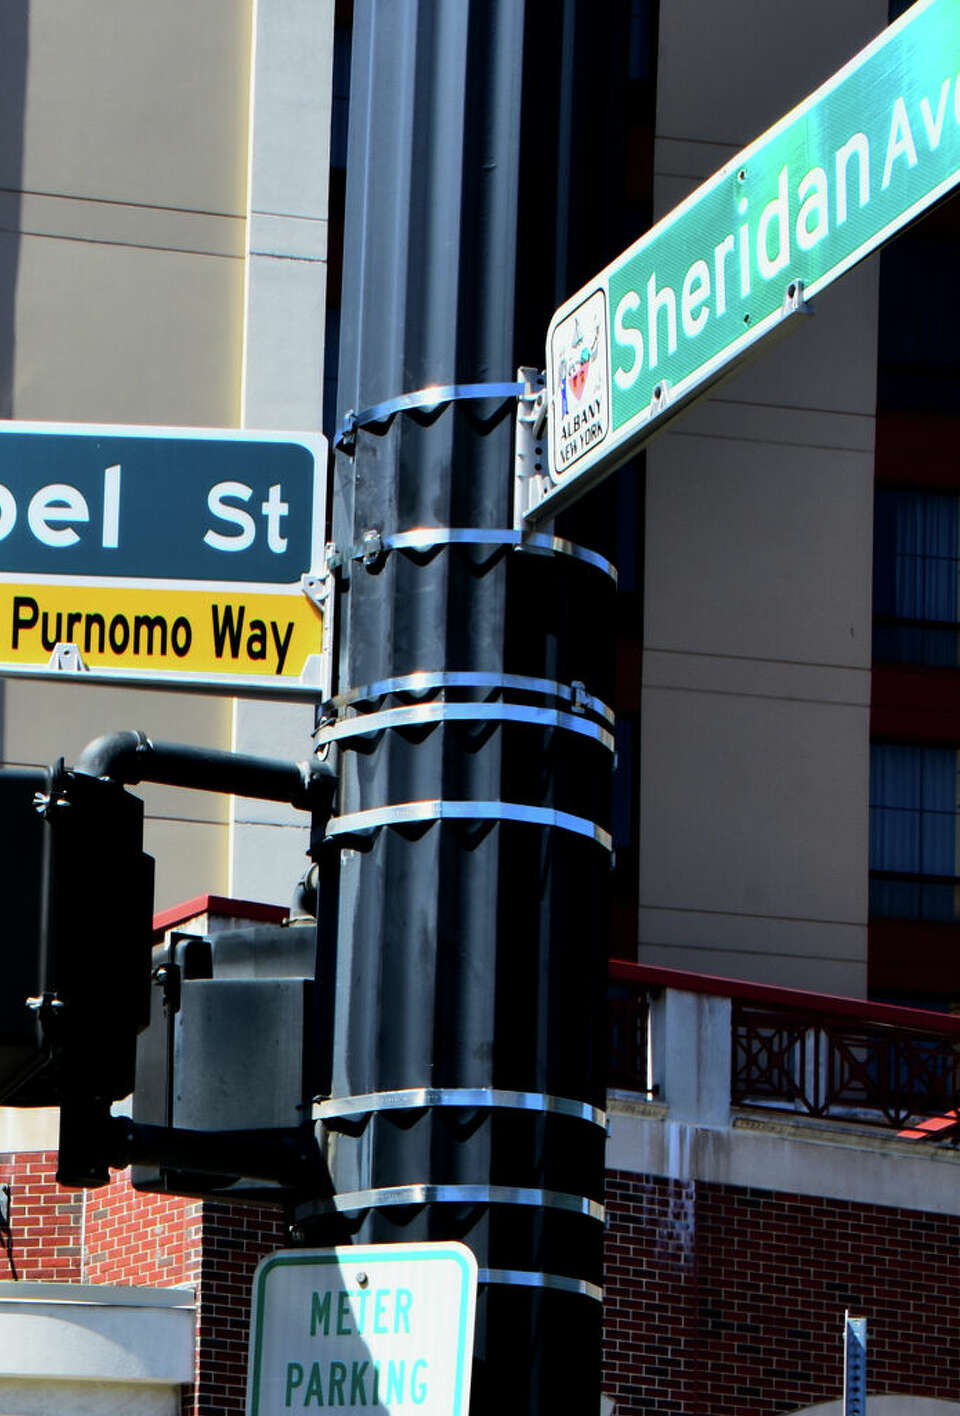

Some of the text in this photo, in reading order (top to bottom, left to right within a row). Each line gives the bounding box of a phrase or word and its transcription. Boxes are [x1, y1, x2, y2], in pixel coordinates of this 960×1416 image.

[614, 74, 960, 391] Sheridan Av
[560, 423, 603, 463] NEW YORK
[562, 399, 601, 440] ALBANY
[204, 482, 289, 554] St
[12, 596, 192, 660] Purnomo
[213, 603, 296, 674] Way
[309, 1288, 413, 1337] METER
[284, 1358, 429, 1408] PARKING
